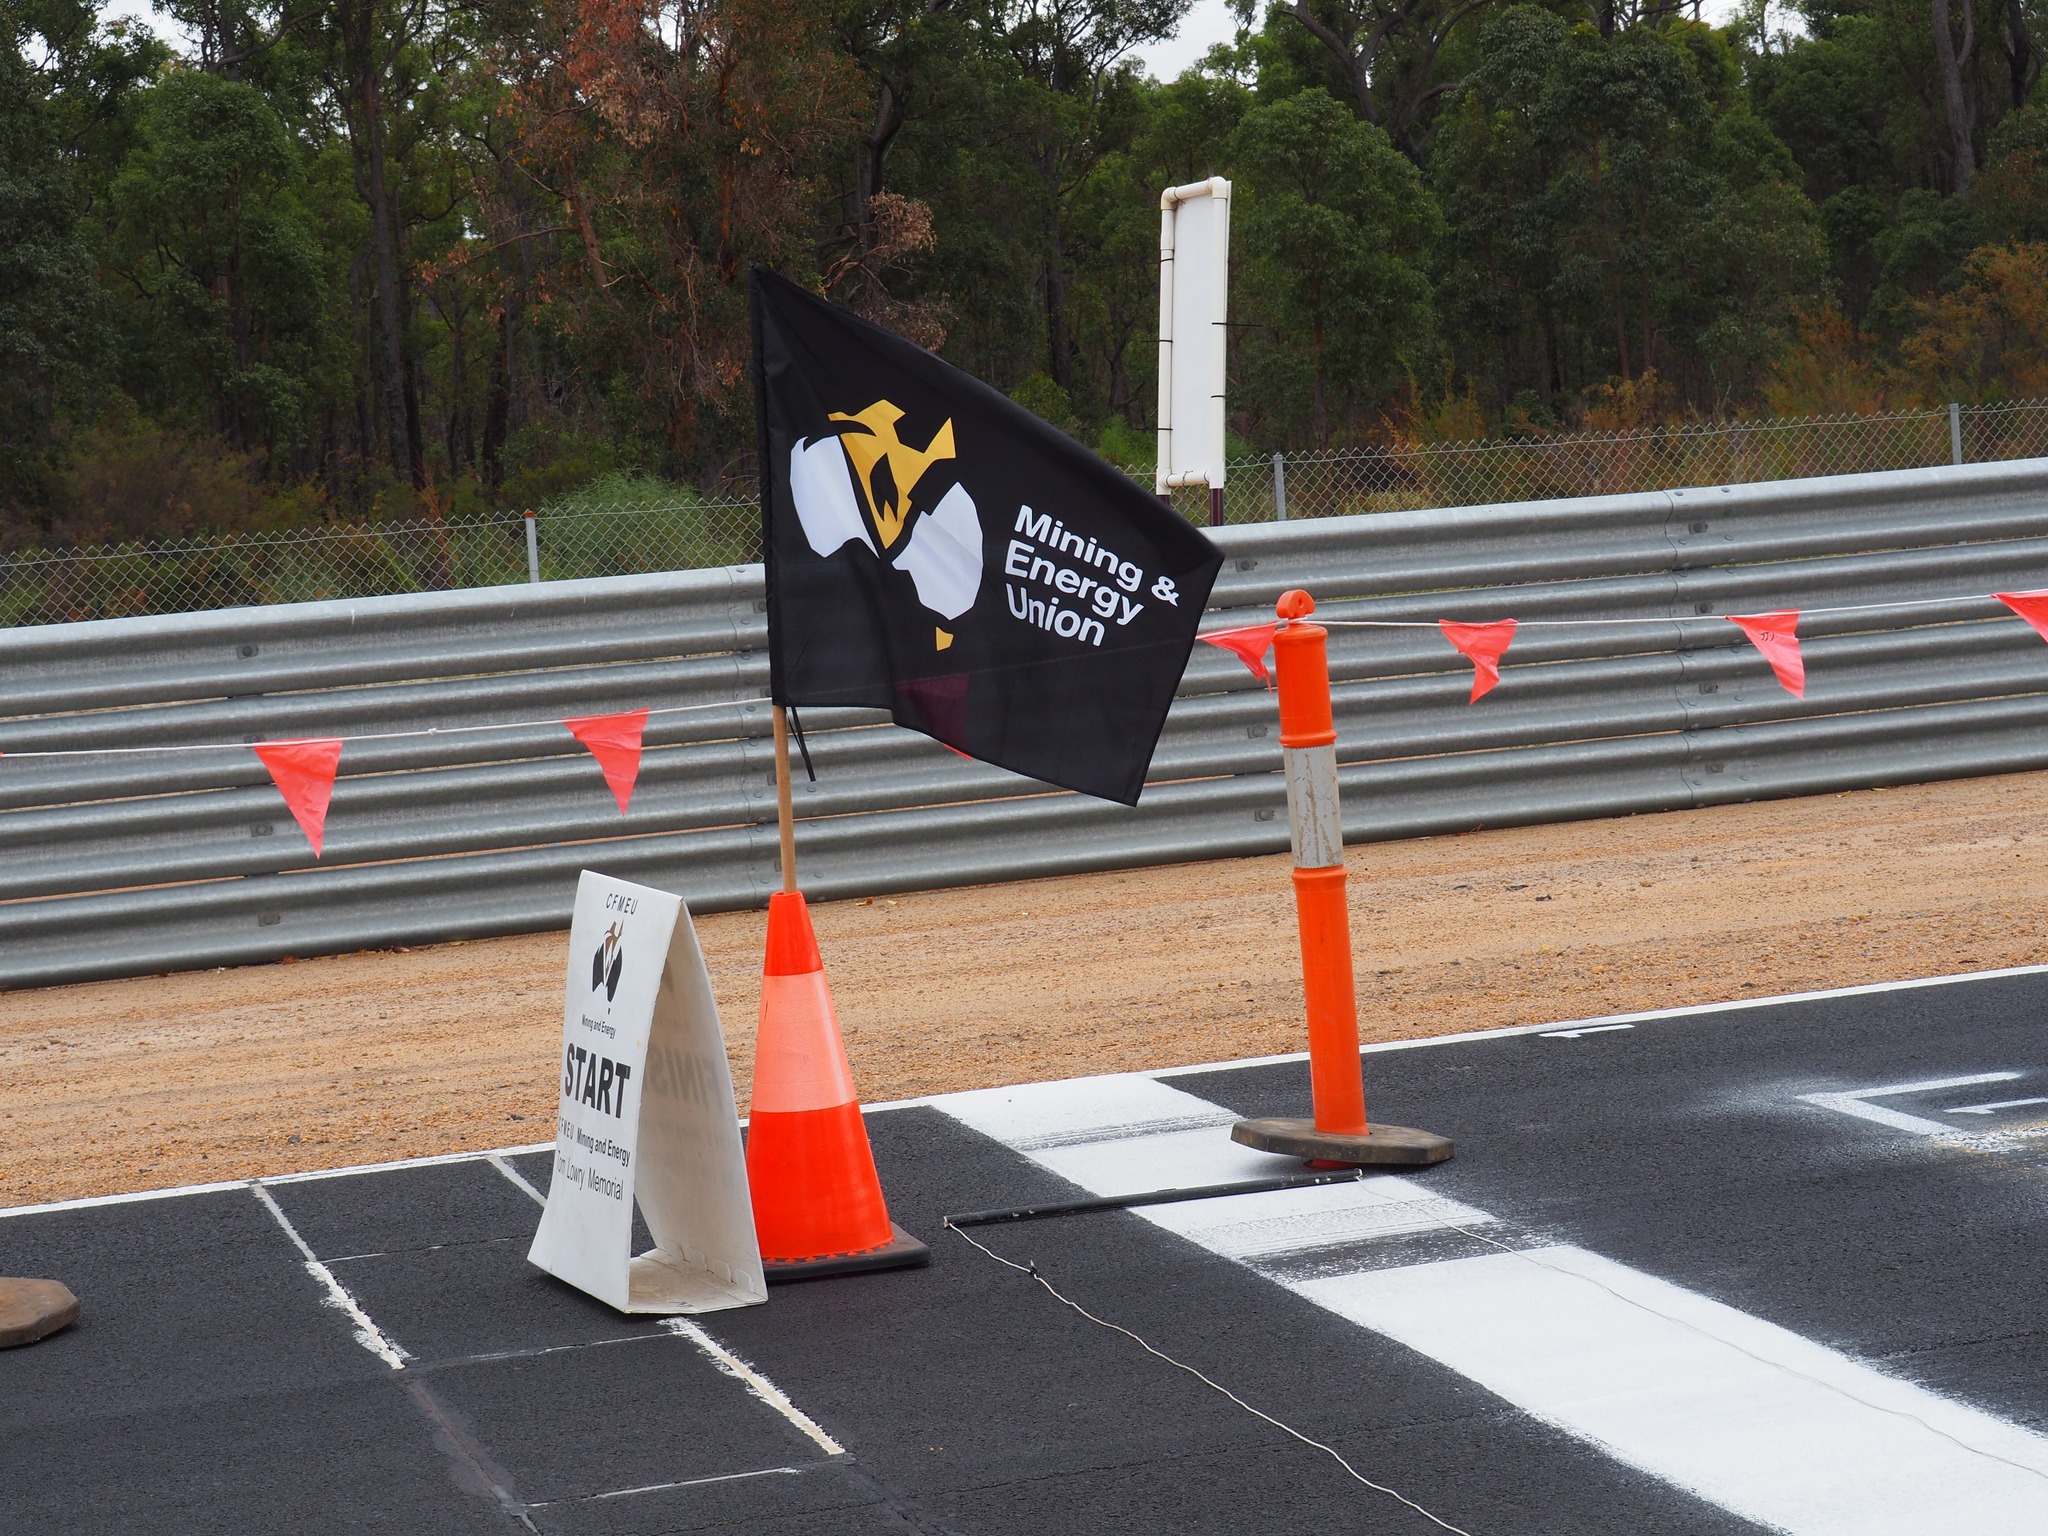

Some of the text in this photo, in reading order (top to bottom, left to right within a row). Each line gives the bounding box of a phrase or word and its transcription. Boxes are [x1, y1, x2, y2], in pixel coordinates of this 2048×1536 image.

[1004, 539, 1145, 626] Energy
[1014, 504, 1180, 607] Mining &
[1005, 582, 1106, 647] Union
[605, 893, 639, 916] CFMEU
[582, 1013, 617, 1040] Mining and Energy
[564, 1042, 632, 1119] START
[576, 1126, 594, 1154] Mining
[594, 1138, 607, 1155] and
[607, 1139, 631, 1168] Energy
[566, 1157, 586, 1191] Lowry
[588, 1166, 624, 1201] Memorial
